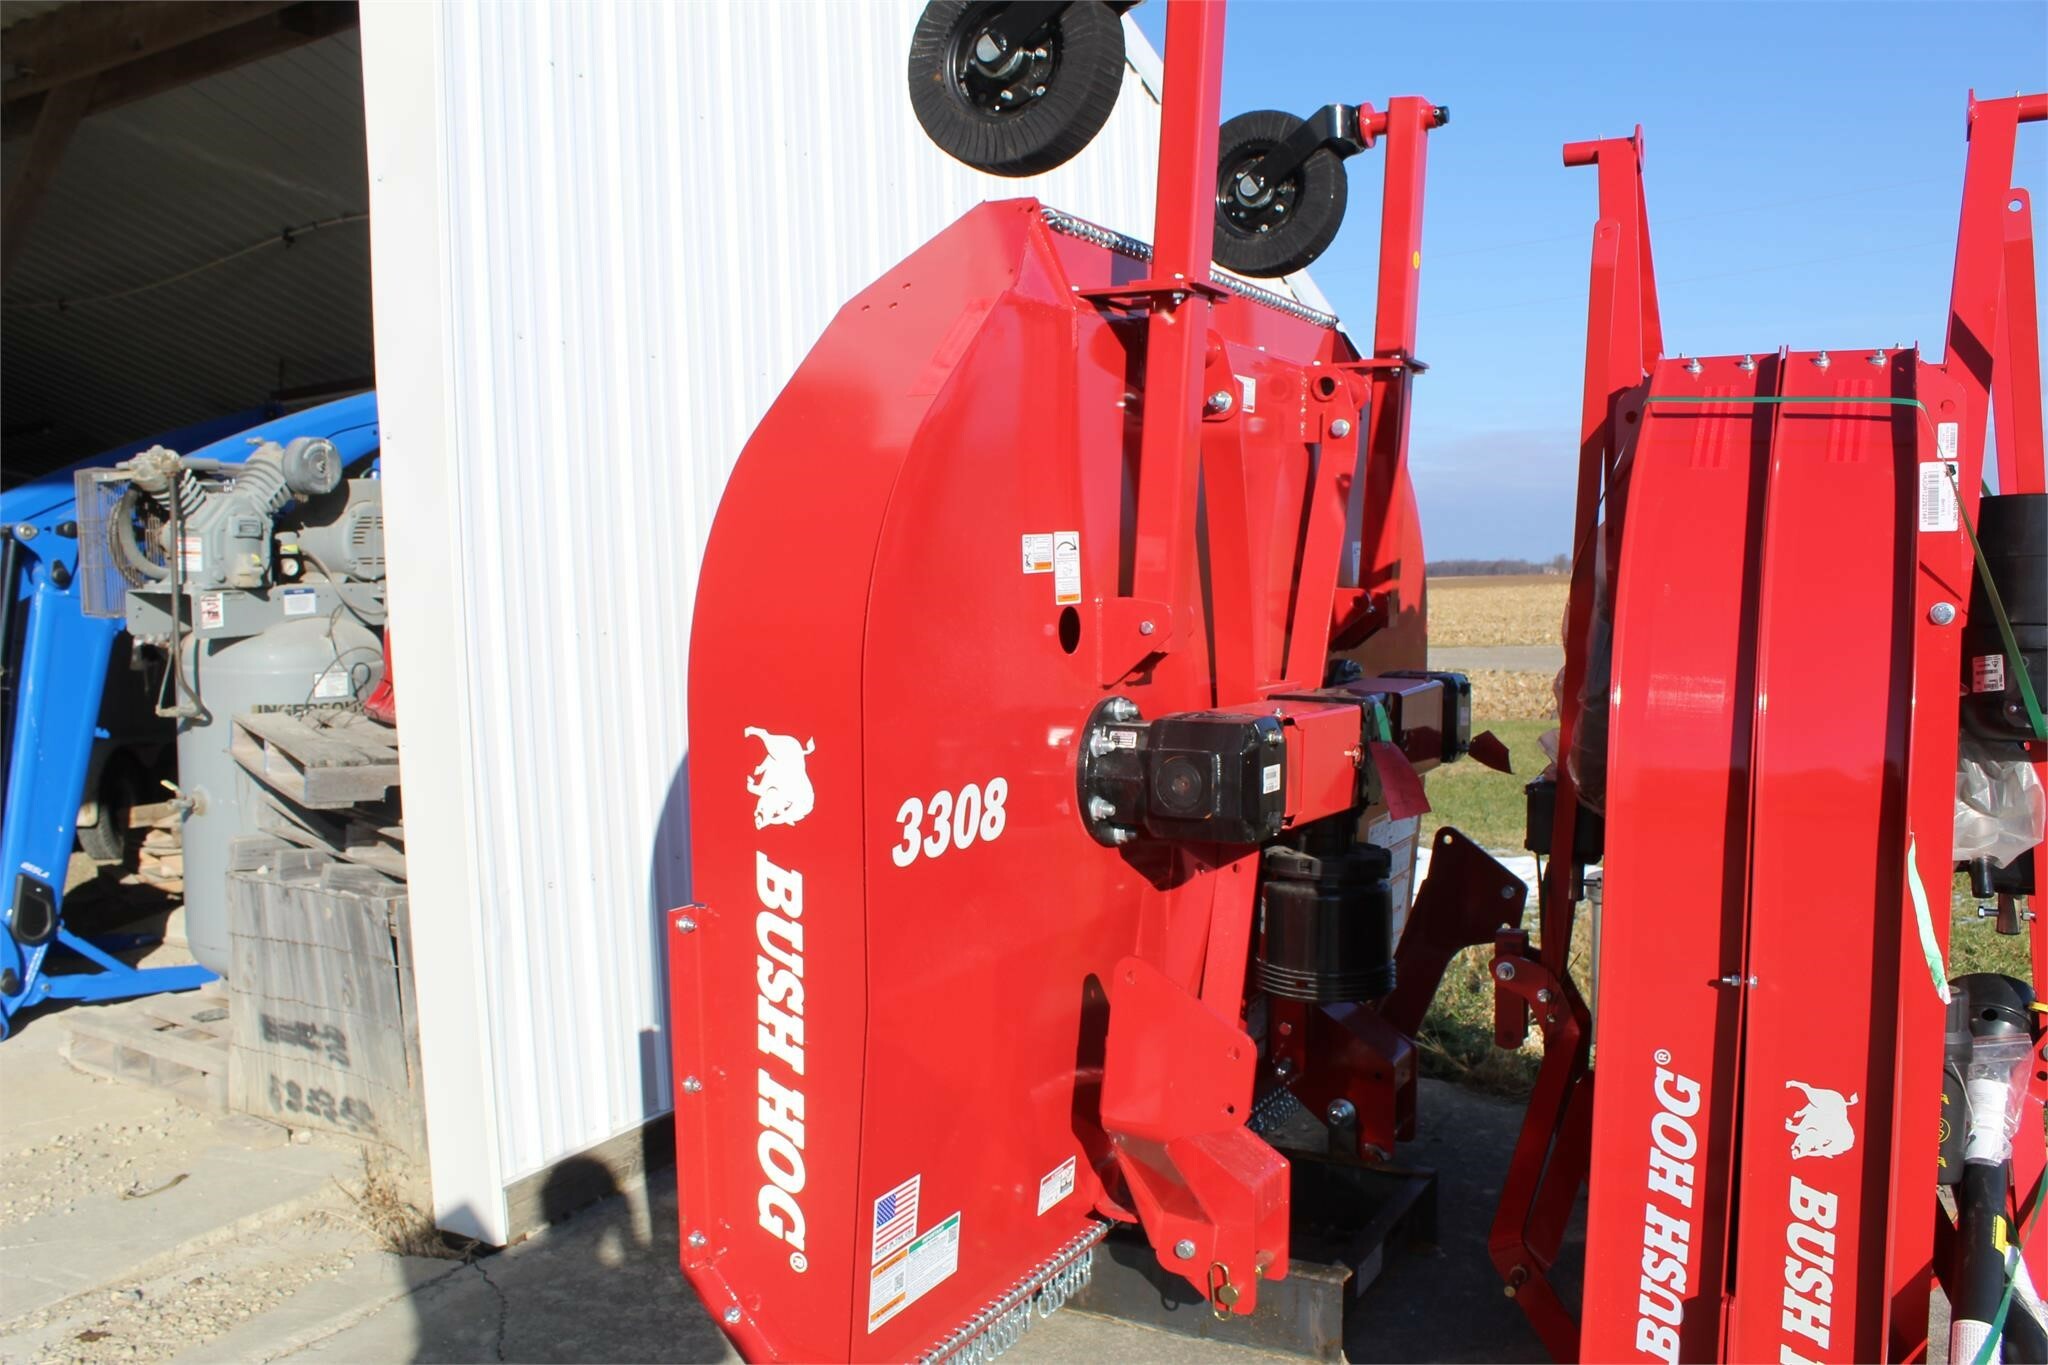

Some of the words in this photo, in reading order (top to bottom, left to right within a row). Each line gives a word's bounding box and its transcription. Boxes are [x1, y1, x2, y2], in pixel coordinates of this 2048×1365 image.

[893, 778, 1008, 867] 3308
[756, 851, 805, 1076] BUSH
[1636, 1203, 1691, 1365] BUSH
[1782, 1176, 1838, 1350] BUSH
